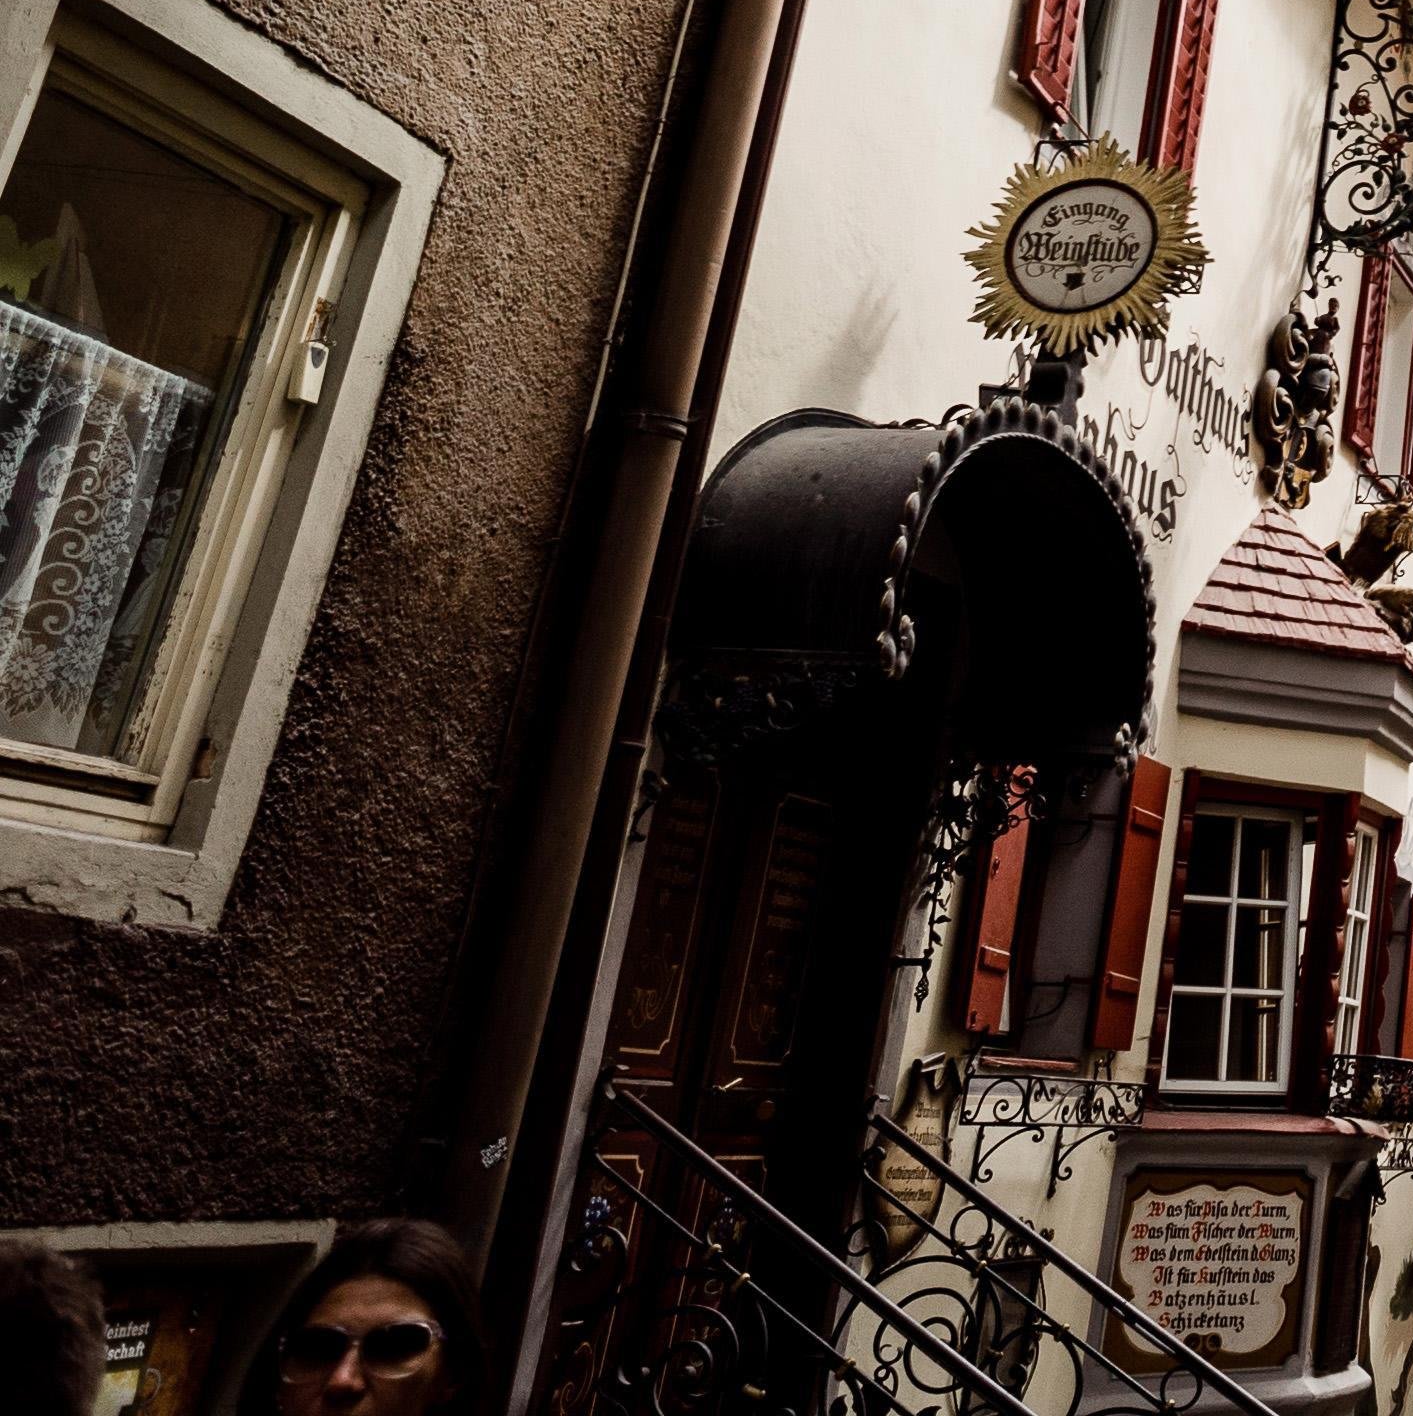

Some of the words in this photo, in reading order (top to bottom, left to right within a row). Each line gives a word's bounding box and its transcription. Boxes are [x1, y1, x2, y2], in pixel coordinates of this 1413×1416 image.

[1041, 201, 1129, 234] Eingang
[1148, 1200, 1183, 1218] Was
[1184, 1199, 1202, 1220] für
[1201, 1200, 1228, 1220] Pisa
[1231, 1199, 1252, 1218] der
[1251, 1200, 1290, 1220] Turm,
[1131, 1223, 1164, 1240] Was
[1191, 1221, 1233, 1242] Fischer
[1238, 1222, 1258, 1239] der
[1257, 1222, 1299, 1242] Wurm,
[1131, 1246, 1166, 1263] Was
[1169, 1245, 1195, 1263] dem
[1194, 1244, 1249, 1265] Edelstein
[1153, 1265, 1174, 1285] Ist
[1177, 1267, 1197, 1286] für
[1196, 1266, 1250, 1286] Kufstein
[1252, 1267, 1275, 1283] das
[1158, 1312, 1245, 1334] Schicketanz
[103, 1340, 147, 1362] schaft
